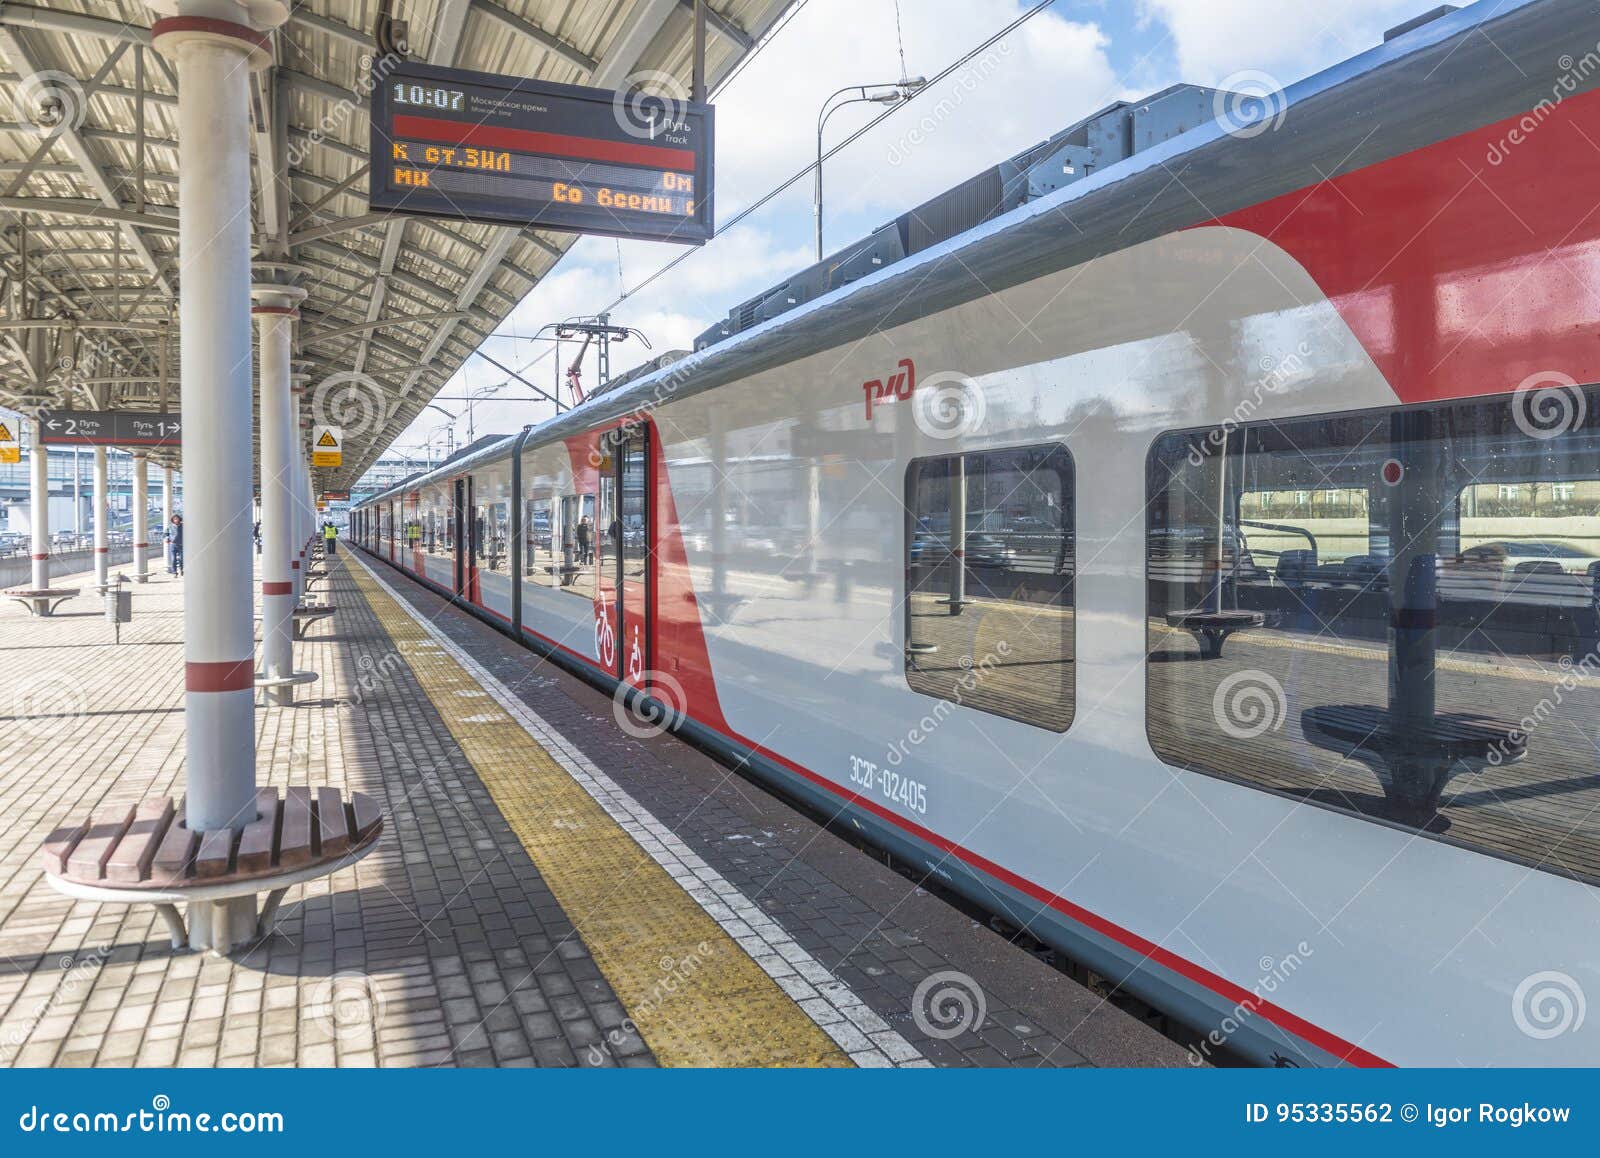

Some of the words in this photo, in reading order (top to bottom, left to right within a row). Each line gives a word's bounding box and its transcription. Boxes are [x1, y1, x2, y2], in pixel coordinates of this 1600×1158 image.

[393, 83, 464, 110] 10:07
[645, 116, 655, 140] 1
[663, 118, 691, 133] Путь
[664, 134, 689, 145] Track
[65, 419, 77, 435] 2
[157, 422, 165, 437] 1
